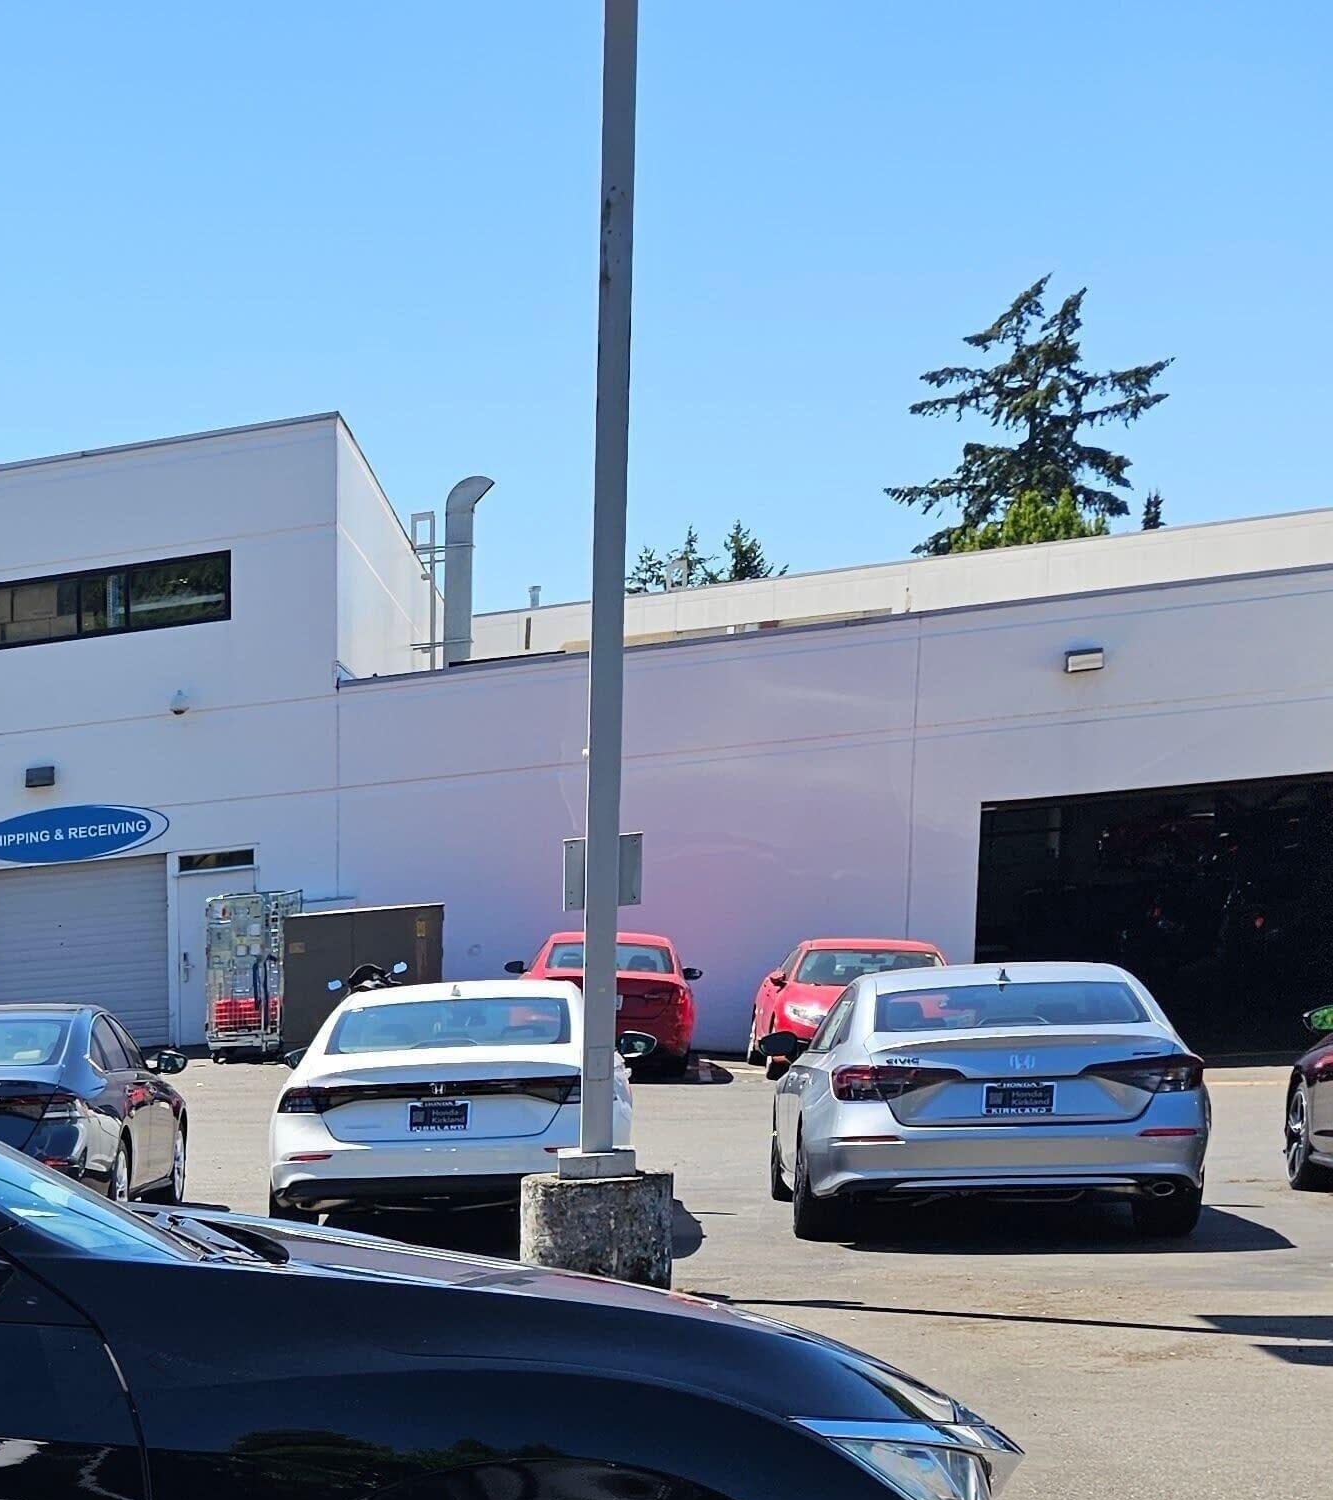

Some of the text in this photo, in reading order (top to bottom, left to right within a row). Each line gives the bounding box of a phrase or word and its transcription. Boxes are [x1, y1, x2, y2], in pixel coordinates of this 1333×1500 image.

[53, 829, 64, 841] &
[67, 820, 147, 839] RECEIVING
[886, 1057, 920, 1065] CIVIC
